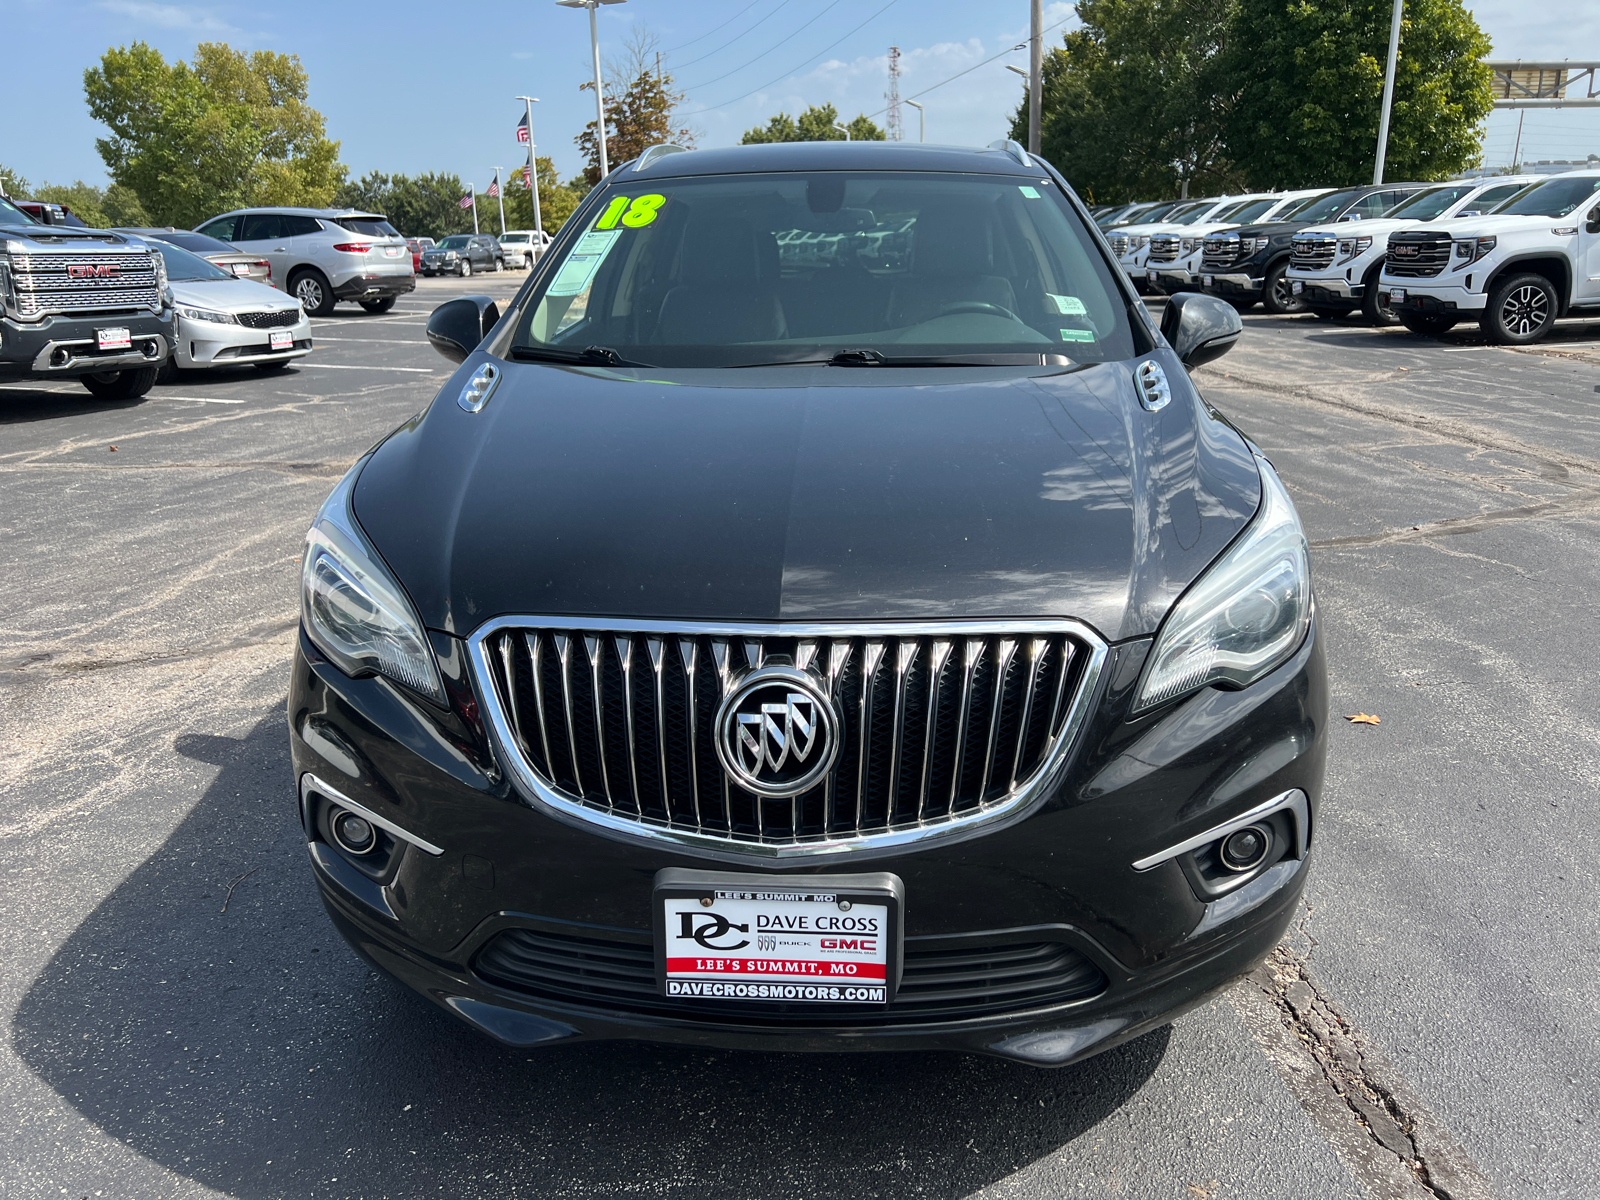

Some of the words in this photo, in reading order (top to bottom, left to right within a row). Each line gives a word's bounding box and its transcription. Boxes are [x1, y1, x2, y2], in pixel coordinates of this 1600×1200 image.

[596, 194, 666, 229] 18
[1395, 246, 1419, 255] GMC
[68, 265, 120, 278] GMC
[717, 892, 752, 900] LEE'S
[756, 893, 807, 901] SUMMIT
[675, 911, 751, 951] DC
[757, 915, 809, 930] DAVE
[815, 917, 879, 931] CROSS
[820, 938, 877, 951] GMC
[696, 959, 741, 971] LEE'S
[747, 961, 823, 976] SUMMIT,
[830, 964, 858, 975] MO
[669, 982, 883, 1001] DAVECROSSMOTORS.COM
